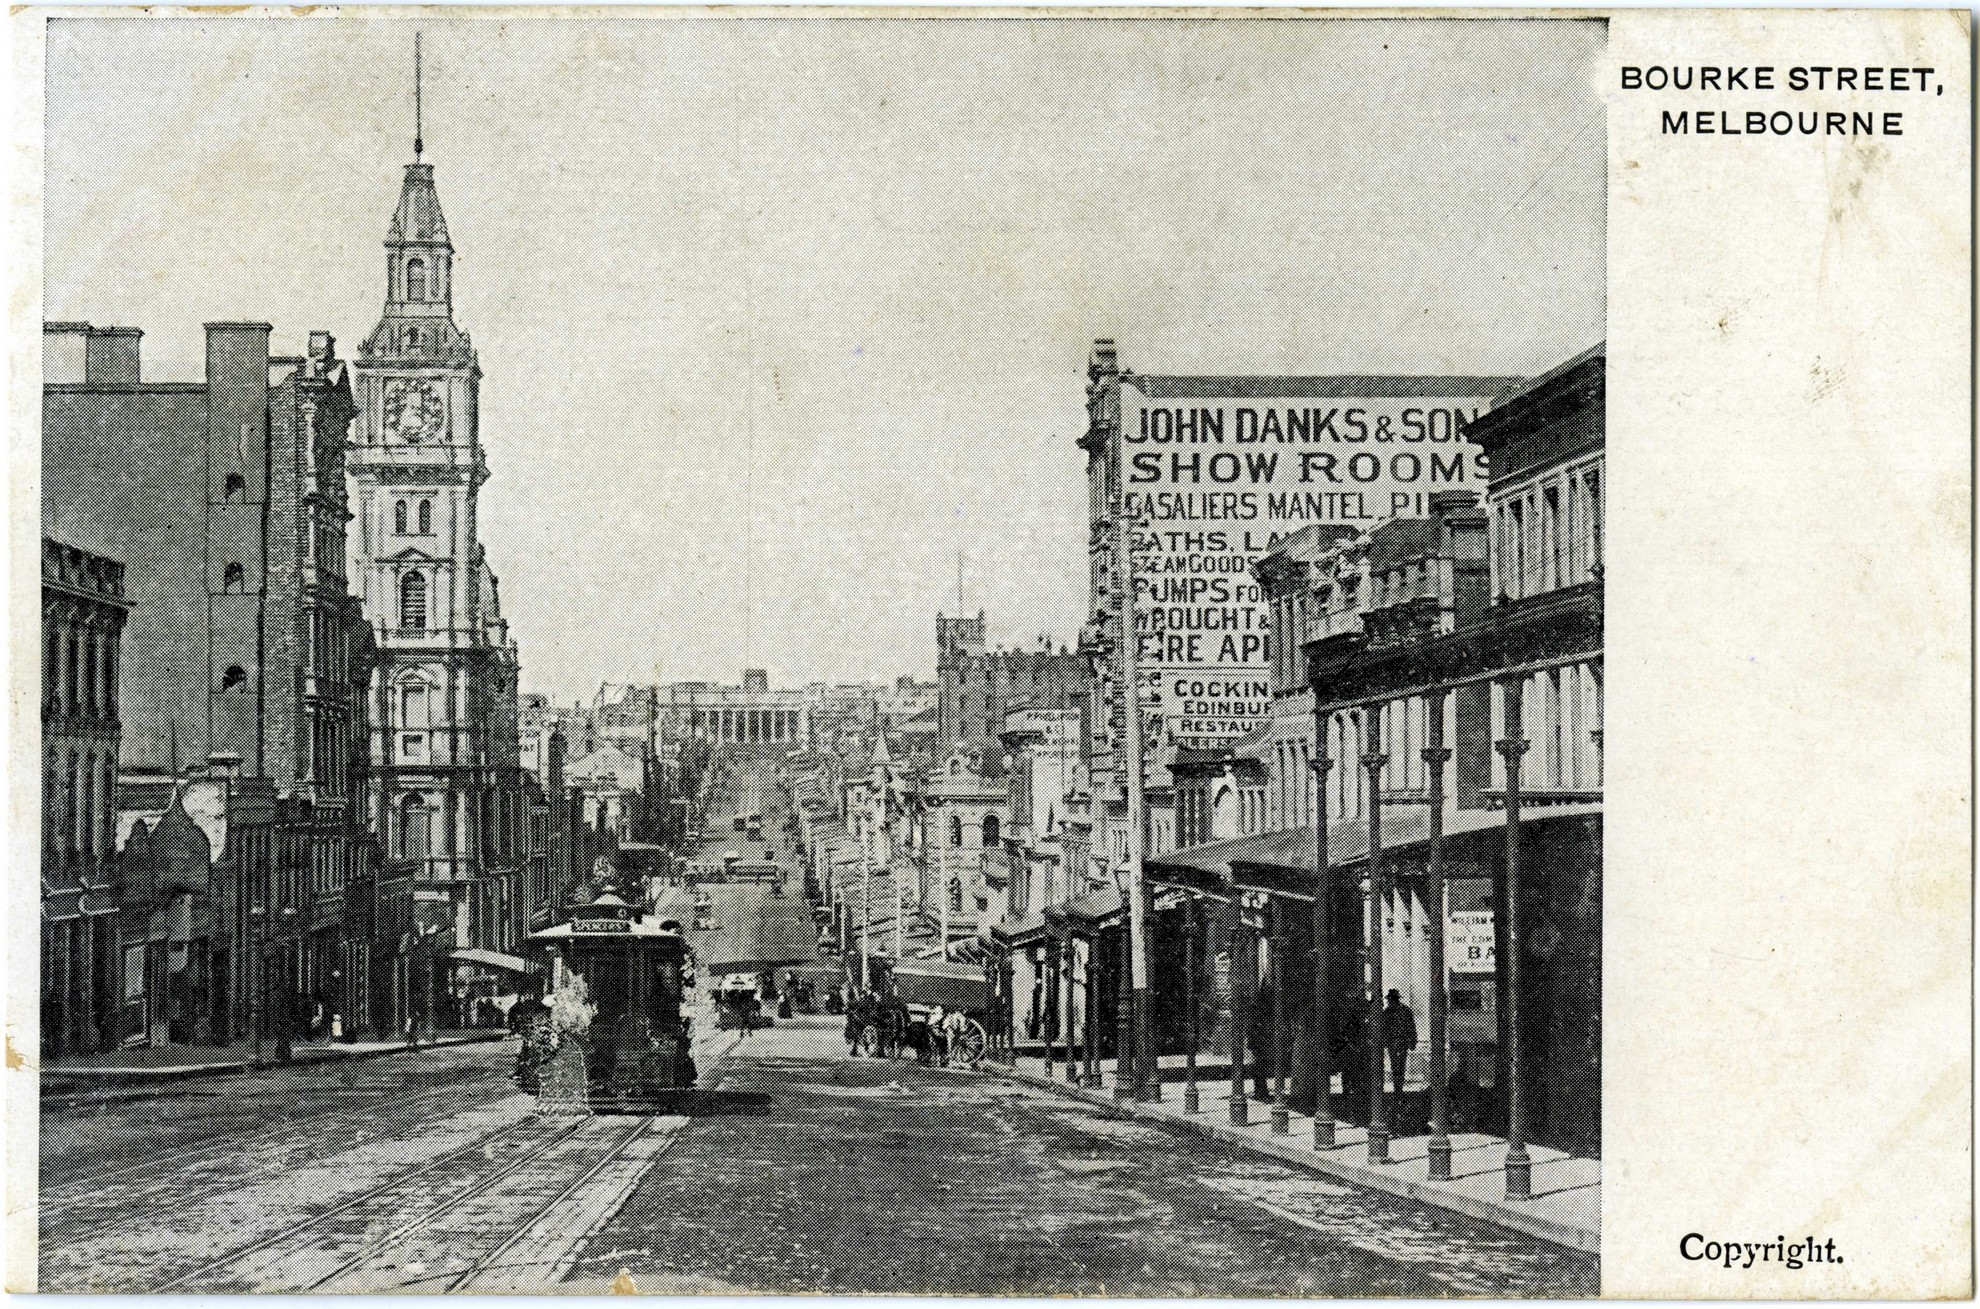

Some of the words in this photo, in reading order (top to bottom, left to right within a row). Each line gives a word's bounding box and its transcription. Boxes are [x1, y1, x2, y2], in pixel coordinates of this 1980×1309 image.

[1125, 408, 1223, 443] JOHN
[1236, 408, 1367, 443] DANKS
[1375, 415, 1396, 442] &
[1129, 452, 1279, 483] SHOW
[1299, 452, 1490, 482] ROOMS
[1123, 492, 1258, 520] GASALIERS
[1132, 578, 1229, 602] PUMPS
